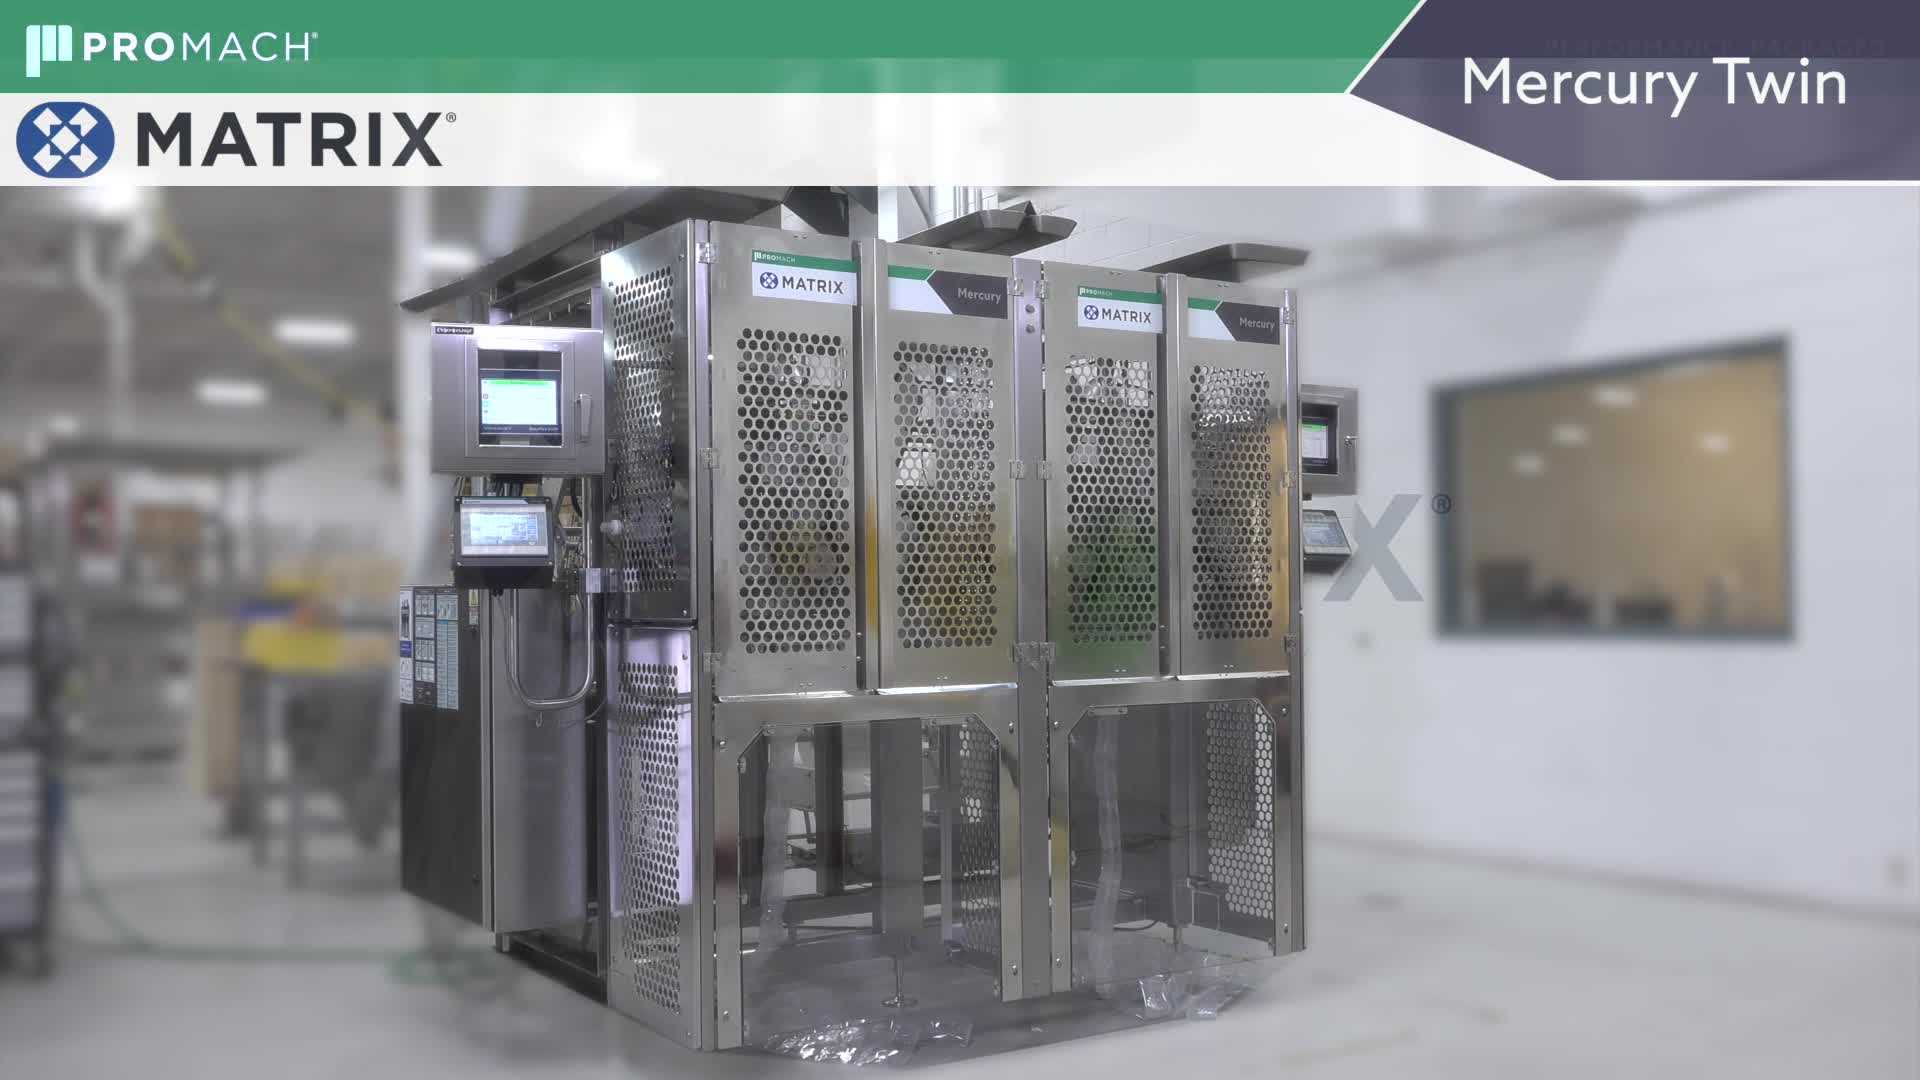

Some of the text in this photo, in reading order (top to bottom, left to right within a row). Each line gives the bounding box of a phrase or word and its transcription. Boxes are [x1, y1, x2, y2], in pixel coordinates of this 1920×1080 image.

[782, 275, 844, 295] MATRIX
[957, 287, 1002, 305] Mercury
[1102, 308, 1152, 324] MATRIX
[1239, 316, 1276, 334] Mercury
